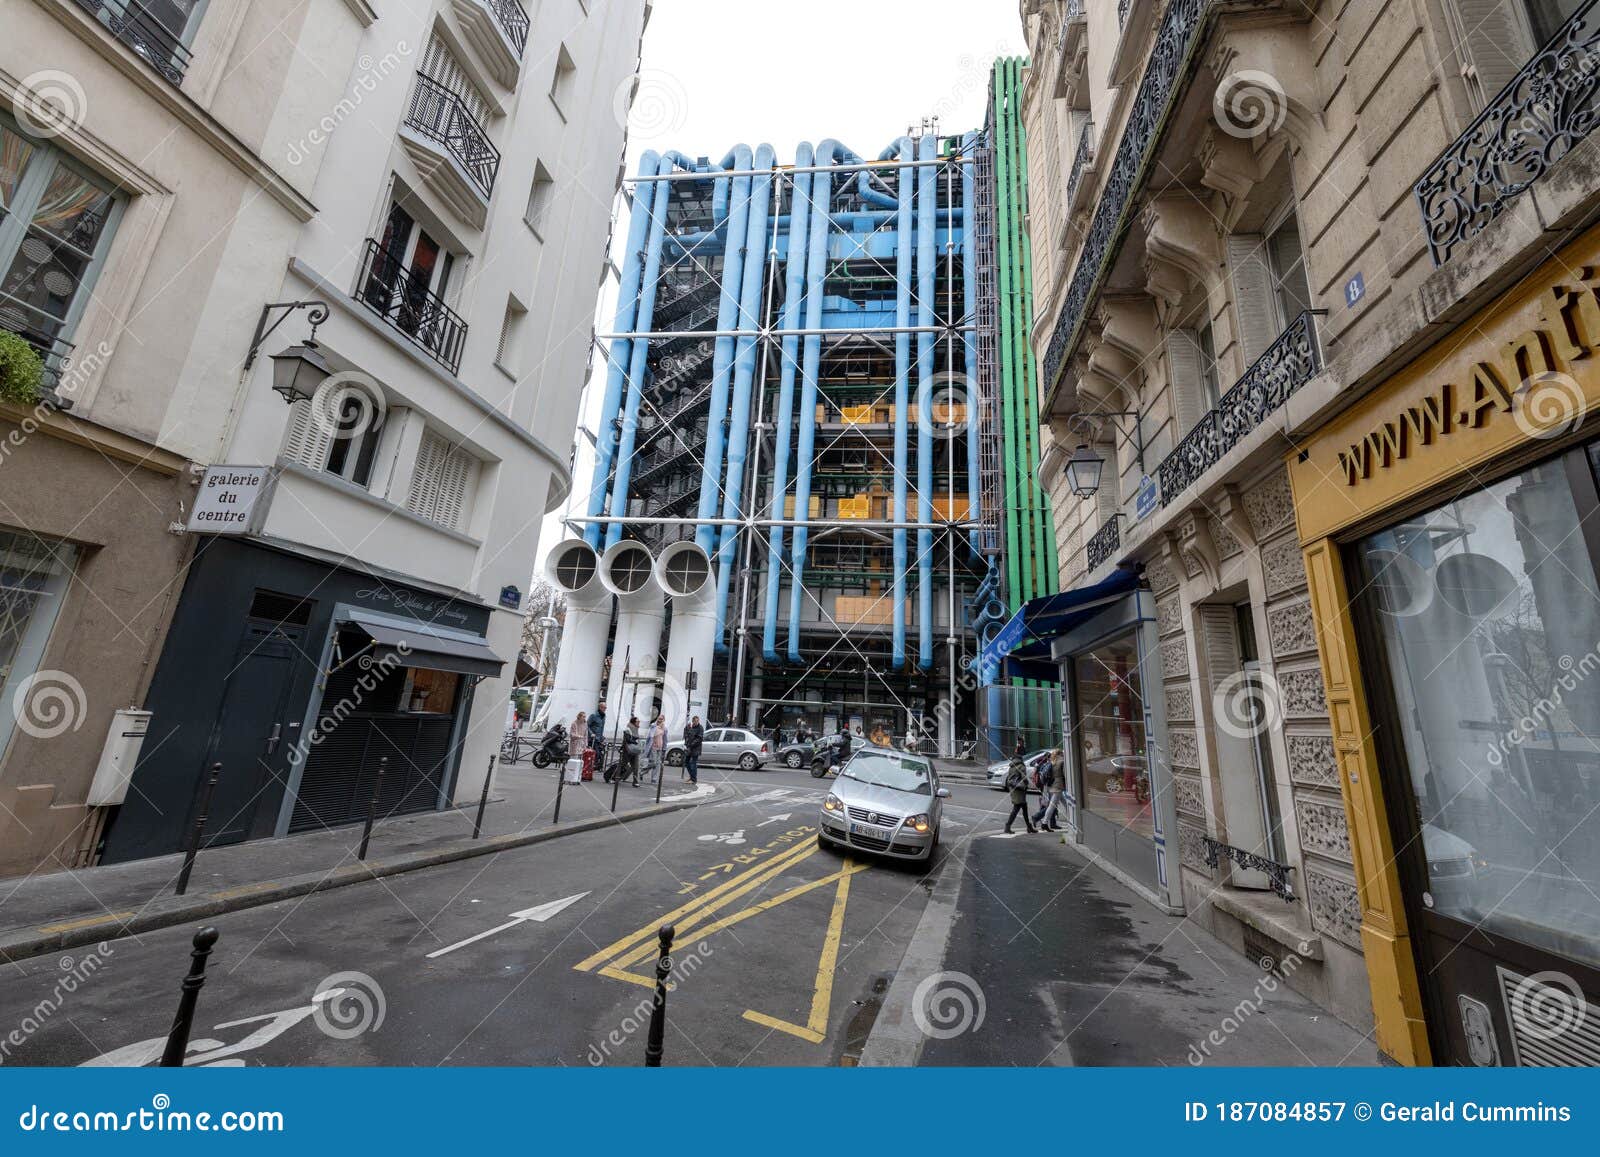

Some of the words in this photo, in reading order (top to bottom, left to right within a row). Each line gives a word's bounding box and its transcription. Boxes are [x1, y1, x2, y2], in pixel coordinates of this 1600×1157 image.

[1349, 280, 1360, 301] 8
[207, 473, 260, 488] galerie
[218, 490, 237, 504] du
[197, 509, 246, 522] centre
